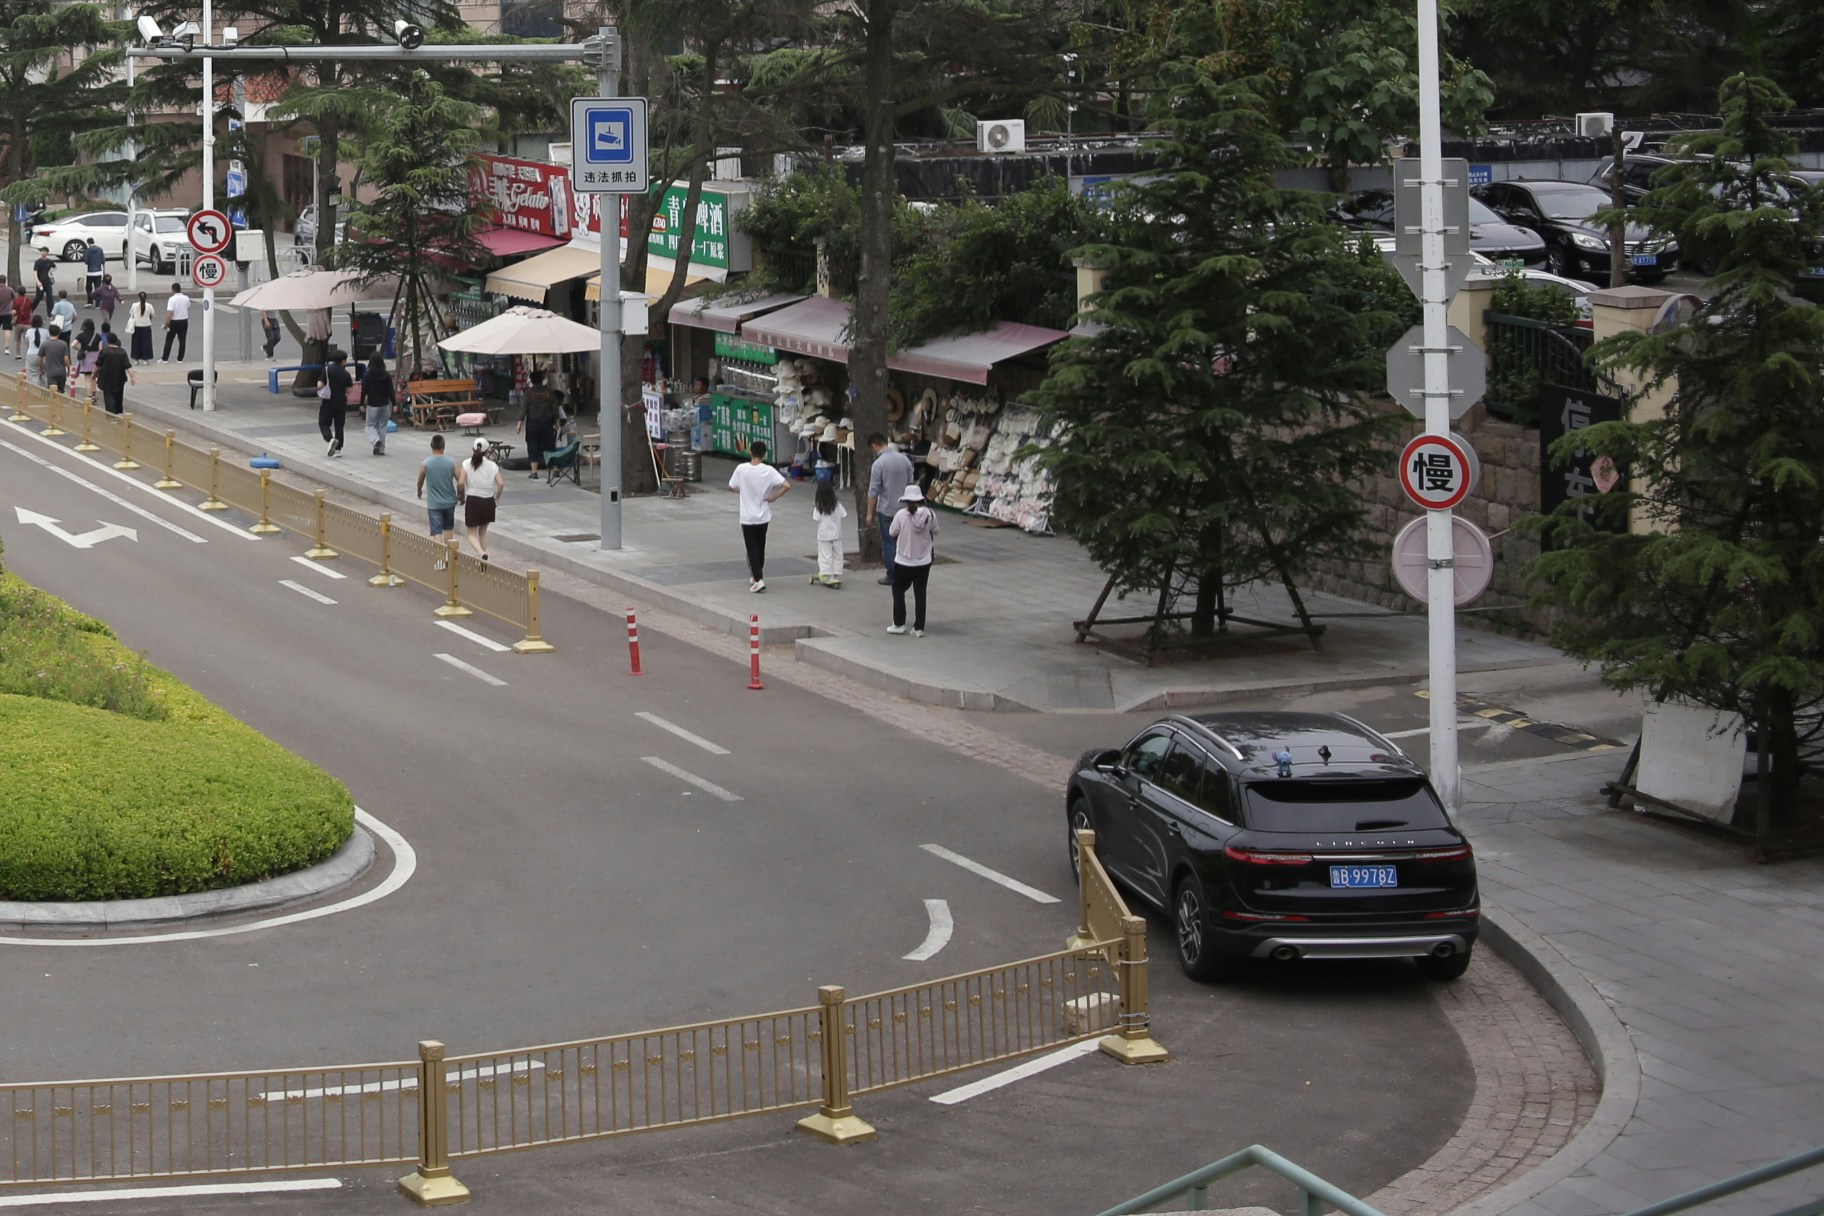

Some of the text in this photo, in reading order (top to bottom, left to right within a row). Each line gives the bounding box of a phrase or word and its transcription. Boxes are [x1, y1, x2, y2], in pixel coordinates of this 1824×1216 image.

[584, 171, 637, 183] 违法抓拍
[511, 183, 549, 212] Gelato
[667, 195, 723, 237] 青啤酒
[199, 263, 218, 280] 慢
[1412, 452, 1454, 493] 慢
